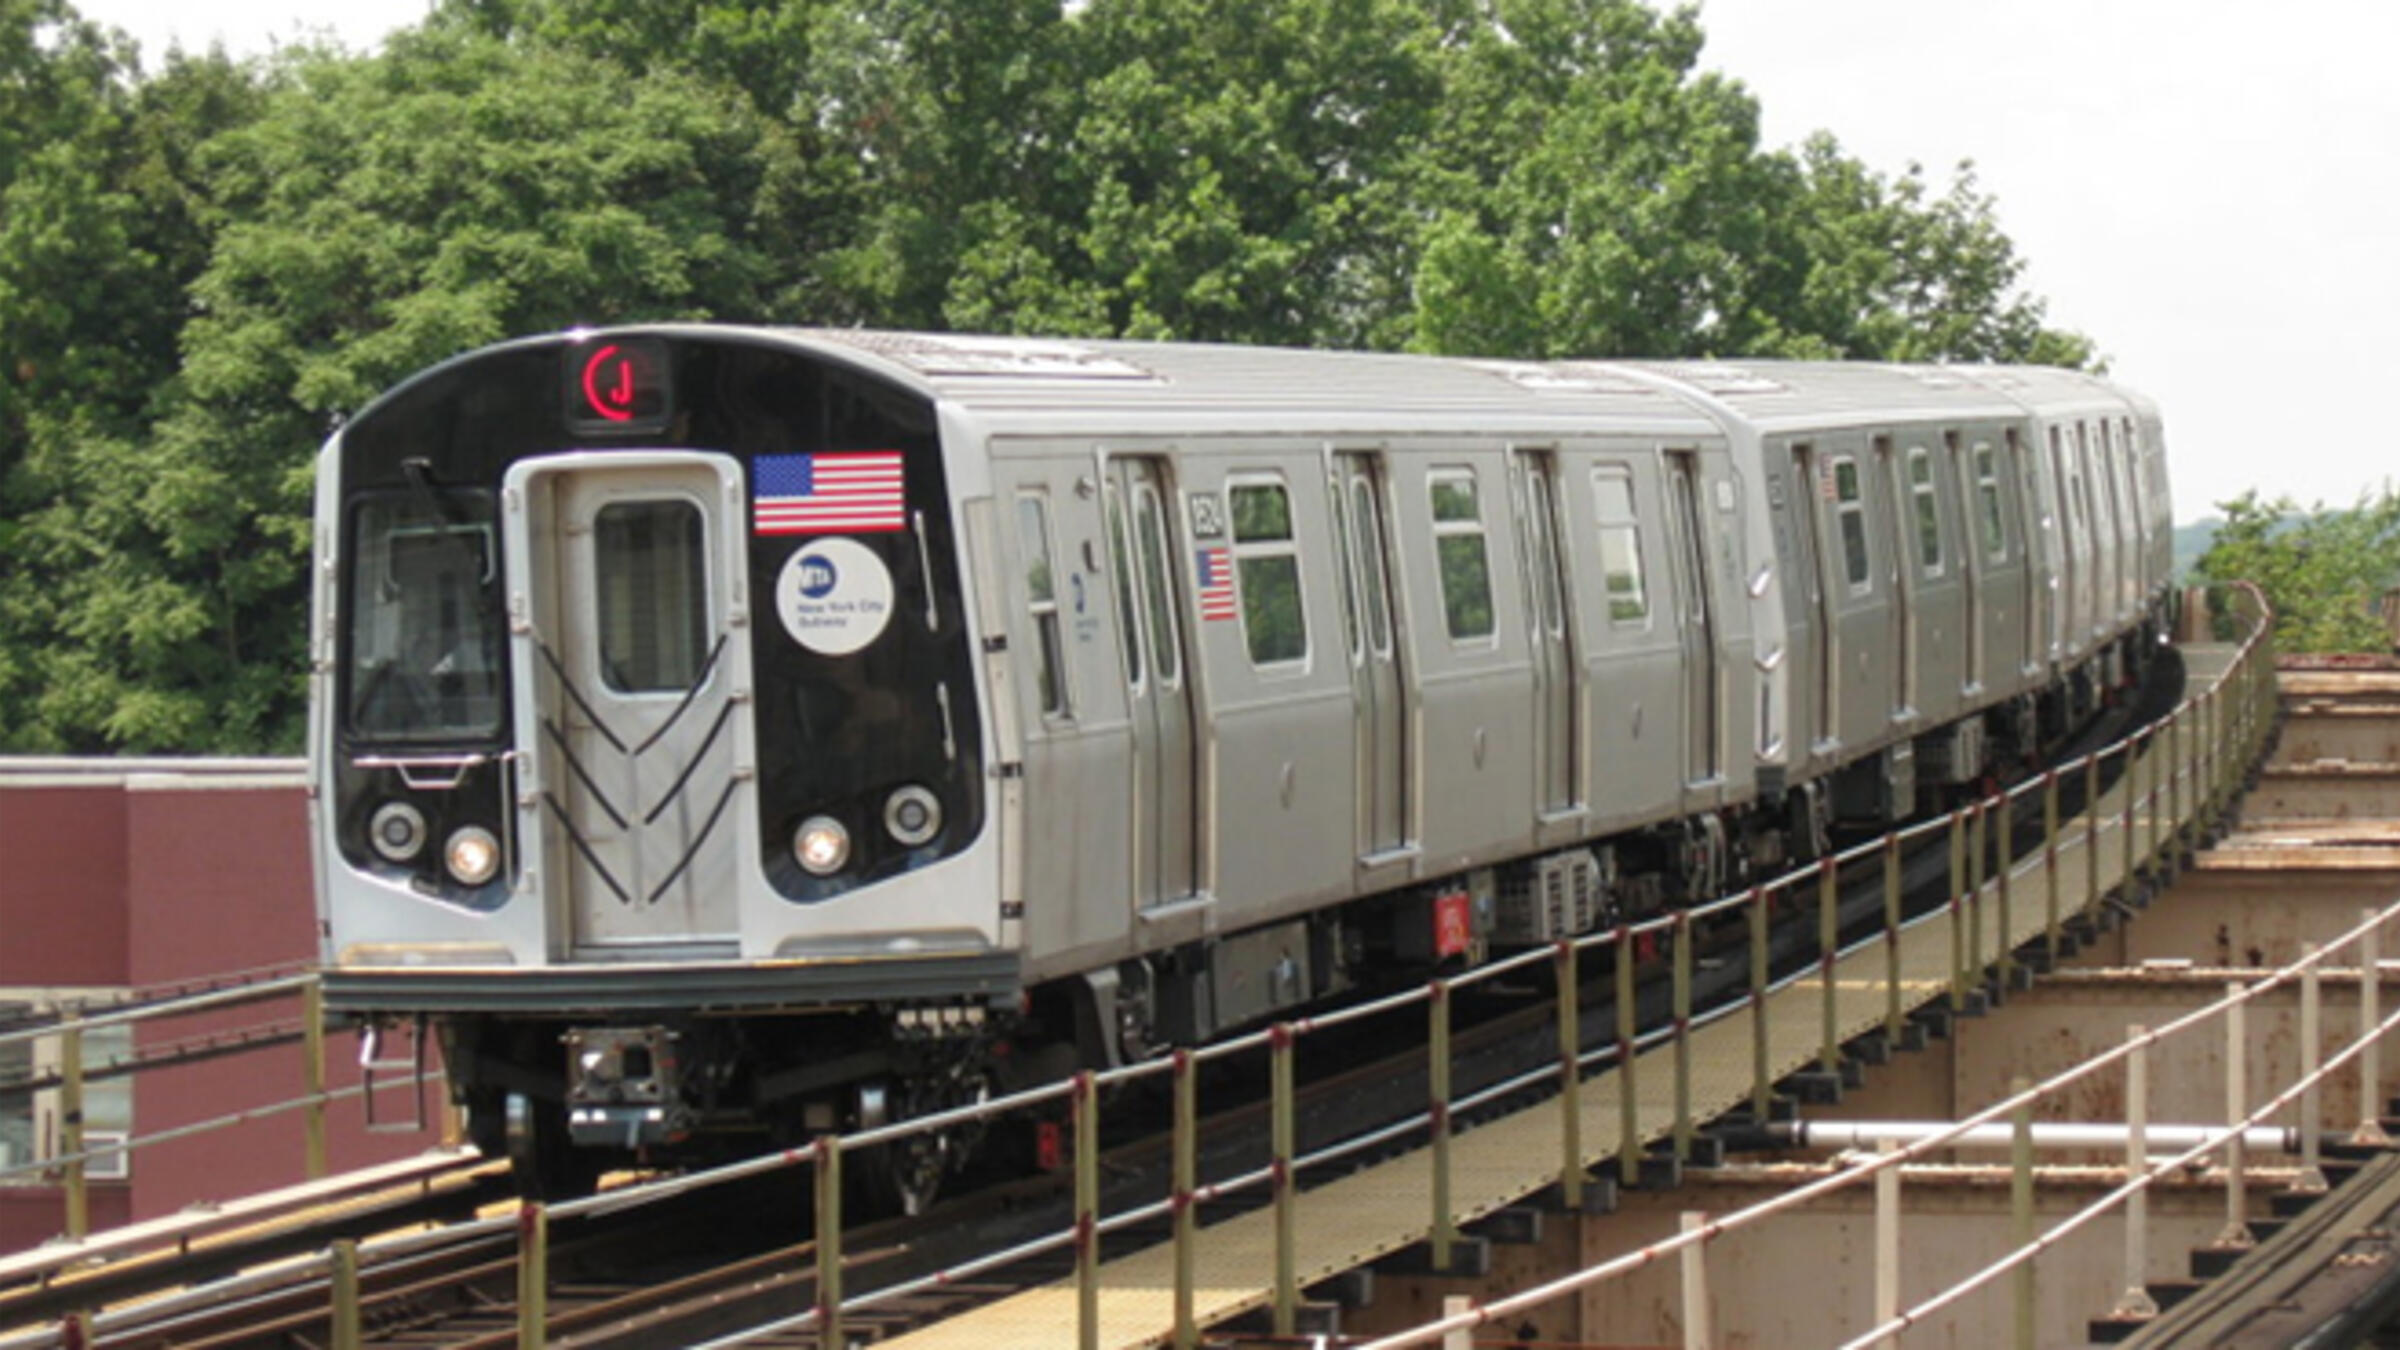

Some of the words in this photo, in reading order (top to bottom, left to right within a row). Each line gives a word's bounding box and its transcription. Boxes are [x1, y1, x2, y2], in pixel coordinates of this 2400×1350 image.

[797, 603, 825, 614] New
[829, 600, 855, 614] York
[860, 599, 884, 615] City
[798, 616, 848, 629] Subway
